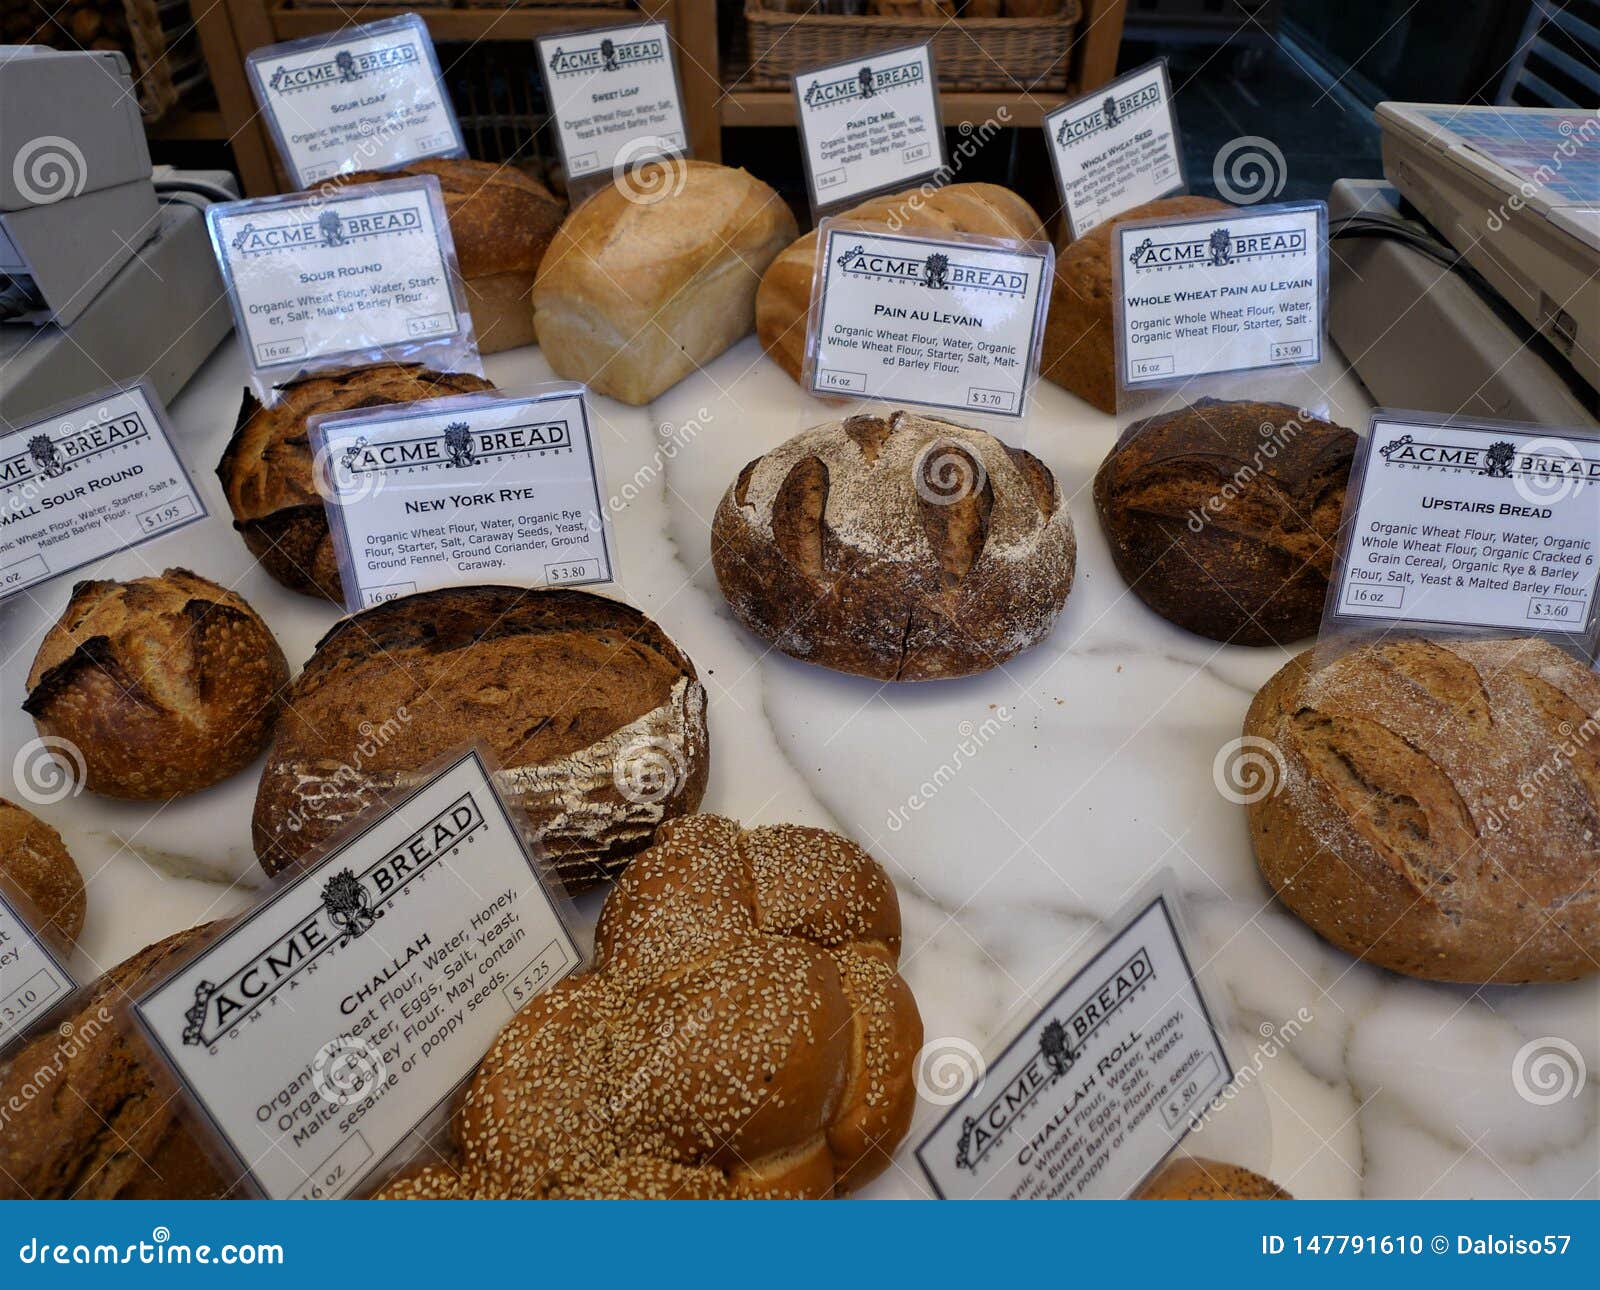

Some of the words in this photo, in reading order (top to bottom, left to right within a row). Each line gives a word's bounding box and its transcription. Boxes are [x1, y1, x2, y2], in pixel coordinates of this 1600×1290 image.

[284, 66, 334, 87] ACME
[361, 47, 413, 69] BREAD
[561, 53, 599, 70] ACME
[620, 43, 659, 60] BREAD
[815, 82, 856, 102] ACME
[877, 66, 919, 86] BREAD
[1066, 115, 1103, 141] ACME
[1119, 87, 1157, 114] BREAD
[251, 226, 313, 249] ACME
[350, 212, 415, 233] BREAD
[1145, 244, 1204, 264] ACME
[1237, 235, 1301, 253] BREAD
[854, 257, 919, 277] ACME
[953, 269, 1022, 289] BREAD
[249, 299, 294, 314] Organic
[297, 293, 333, 306] Wheat
[370, 283, 405, 295] Water,
[408, 277, 440, 288] Start-
[1131, 316, 1171, 331] Organic
[1175, 313, 1206, 325] Whole
[1210, 309, 1243, 321] Wheat
[1247, 305, 1275, 316] Flour,
[1280, 302, 1312, 312] Water,
[827, 336, 857, 349] Whole
[862, 339, 893, 353] Wheat
[897, 345, 923, 357] Flour,
[927, 349, 963, 362] Starter,
[967, 353, 989, 365] Salt,
[994, 357, 1019, 368] Malt-
[834, 325, 872, 338] Organic
[877, 328, 907, 342] Wheat
[912, 334, 938, 346] Flour,
[943, 338, 973, 350] Water,
[978, 342, 1016, 355] Organic
[1136, 365, 1147, 373] 16
[1149, 364, 1159, 372] oz
[65, 419, 138, 456] BREAD
[362, 442, 440, 466] ACME
[481, 427, 564, 451] BREAD
[1400, 446, 1479, 465] ACME
[1520, 457, 1600, 476] BREAD
[0, 507, 40, 526] MALL
[17, 529, 48, 544] Wheat
[50, 518, 77, 533] Flour,
[79, 504, 112, 521] Water,
[112, 491, 147, 507] Starter,
[149, 483, 167, 494] Salt
[38, 534, 70, 549] Malted
[72, 521, 102, 535] Barley
[104, 510, 129, 522] Flour.
[366, 532, 408, 546] Organic
[411, 527, 446, 540] Wheat
[449, 522, 477, 535] Flour,
[481, 519, 515, 531] Water,
[518, 513, 559, 528] Organic
[562, 509, 581, 522] Rye
[365, 545, 394, 558] Flour,
[398, 540, 437, 554] Starter,
[441, 536, 465, 549] Salt,
[469, 530, 513, 546] Caraway
[518, 525, 552, 539] Seeds,
[556, 521, 587, 534] Yeast,
[368, 557, 407, 570] Ground
[411, 551, 449, 565] Fennel,
[452, 545, 492, 560] Ground
[495, 539, 548, 554] Coriander,
[551, 533, 590, 547] Ground
[1370, 521, 1417, 536] Organic
[1422, 525, 1460, 539] Wheat
[1464, 529, 1497, 541] Flour,
[1502, 532, 1539, 545] Water,
[1543, 536, 1591, 550] Organic
[6, 573, 21, 582] oz
[1350, 569, 1383, 581] Flour,
[1387, 571, 1415, 584] Salt,
[1420, 575, 1452, 585] Yeast
[1456, 577, 1464, 587] &
[1468, 578, 1508, 590] Malted
[1512, 581, 1550, 594] Barley
[1554, 584, 1588, 596] Flour.
[1368, 552, 1400, 564] Grain
[1405, 556, 1447, 569] Cereal,
[1452, 558, 1498, 573] Organic
[1502, 563, 1524, 576] Rye
[1528, 566, 1536, 575] &
[1541, 566, 1579, 580] Barley
[215, 919, 327, 1026] ACME
[372, 806, 472, 894] BREAD
[256, 1058, 324, 1122] Organic
[325, 1009, 379, 1059] Wheat
[380, 972, 423, 1011] Flour,
[423, 930, 470, 970] Water,
[470, 888, 518, 929] Honey,
[278, 1069, 345, 1132] Organic
[347, 1019, 399, 1070] Butter,
[400, 983, 442, 1020] Eggs,
[443, 949, 477, 980] Salt,
[477, 913, 520, 947] Yeast,
[293, 1088, 349, 1148] Malted
[353, 1043, 400, 1092] Barley
[403, 1004, 445, 1043] Flour.
[446, 974, 475, 1003] May
[478, 927, 526, 975] contain
[973, 1063, 1044, 1151] ACME
[1072, 959, 1145, 1038] BREAD
